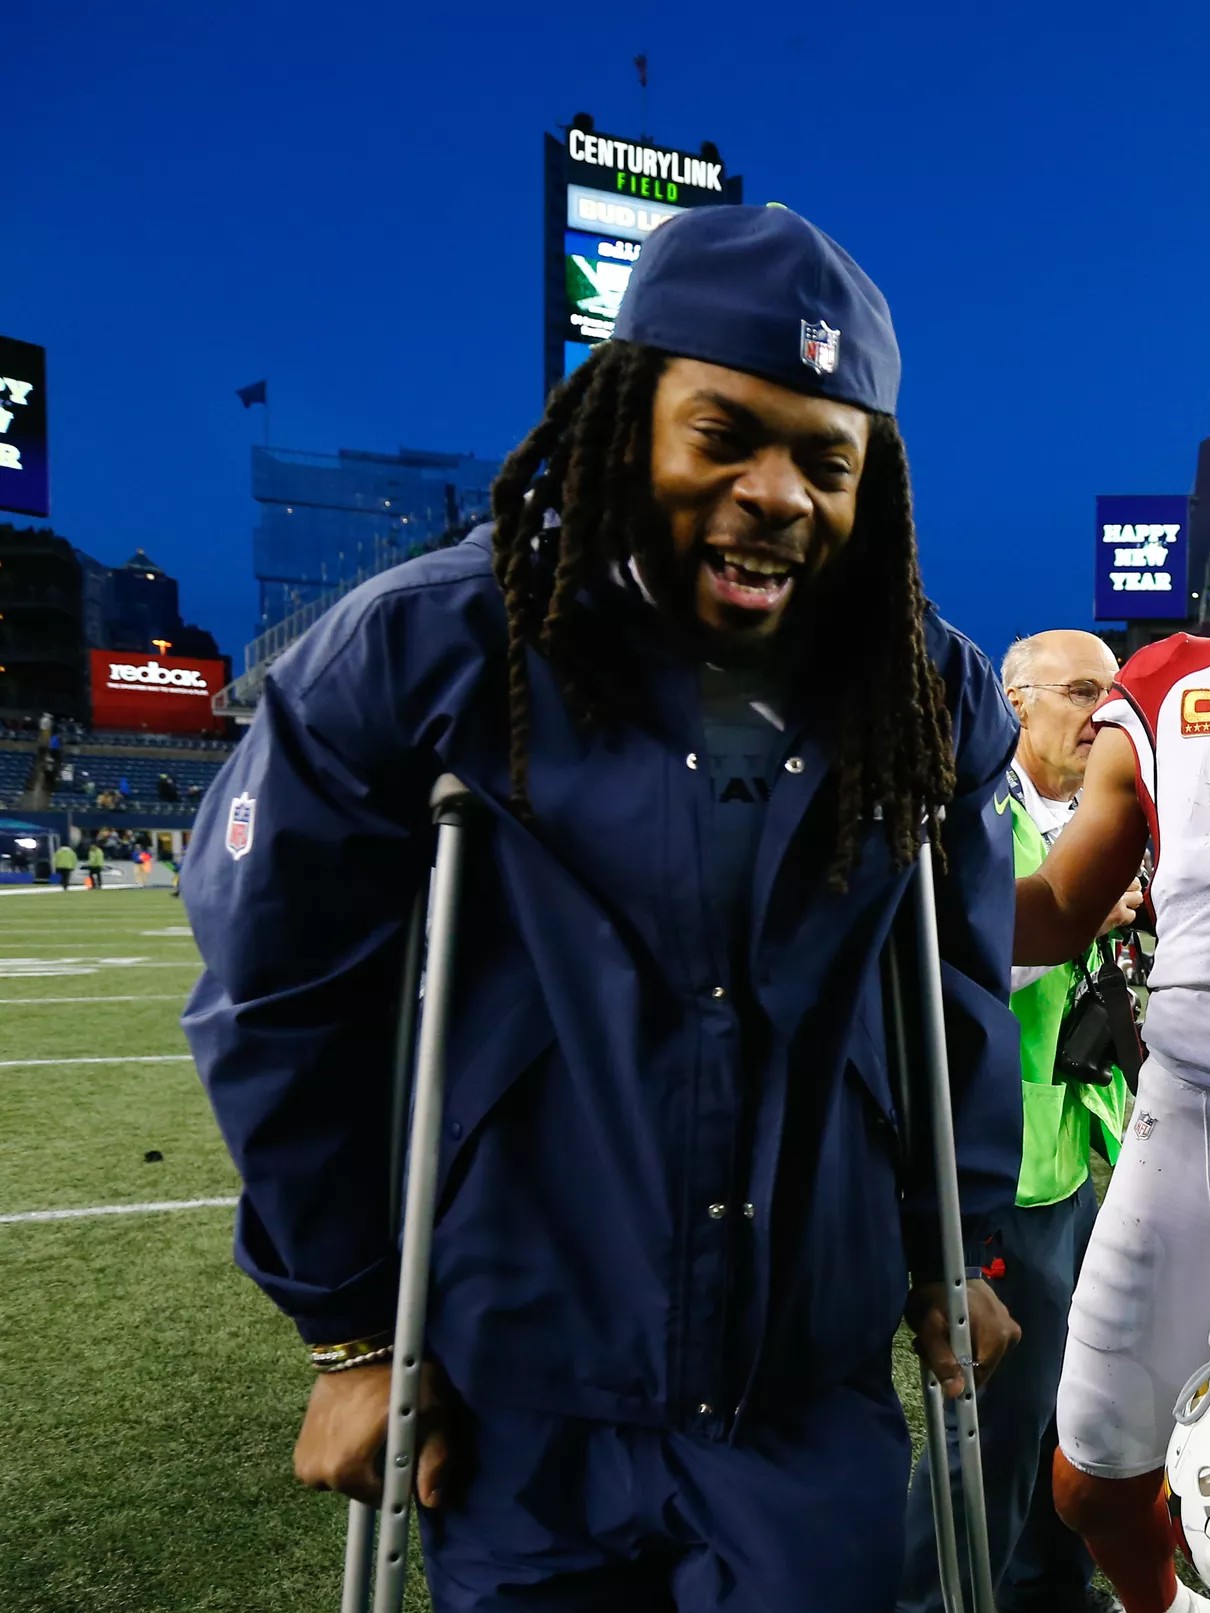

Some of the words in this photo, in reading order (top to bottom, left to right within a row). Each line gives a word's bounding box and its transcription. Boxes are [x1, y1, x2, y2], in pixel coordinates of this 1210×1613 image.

[569, 129, 722, 191] CENTURYLINK
[616, 172, 678, 202] FIELD
[579, 198, 635, 227] BUD
[1103, 524, 1180, 542] HAPPY
[1114, 548, 1168, 566] NEW
[1109, 572, 1172, 591] YEAR
